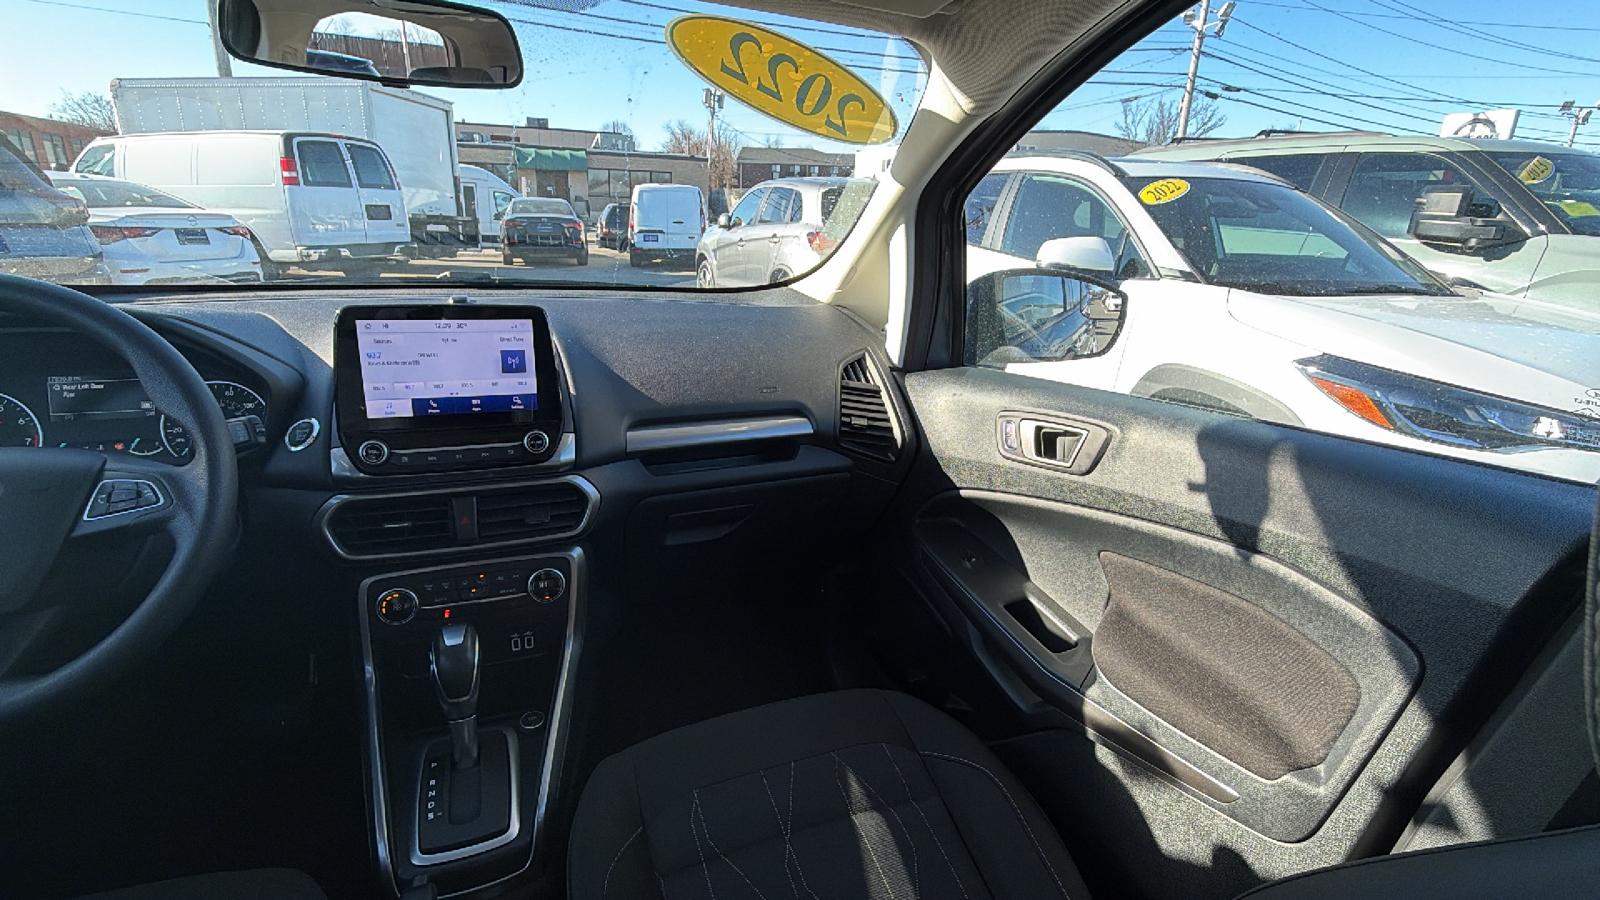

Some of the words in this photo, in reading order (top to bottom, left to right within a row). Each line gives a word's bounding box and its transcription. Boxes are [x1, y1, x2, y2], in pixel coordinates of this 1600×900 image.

[1146, 181, 1182, 201] 2022
[366, 351, 382, 359] 93.7
[18, 417, 25, 425] 6
[25, 438, 32, 446] 7
[428, 801, 435, 809] D
